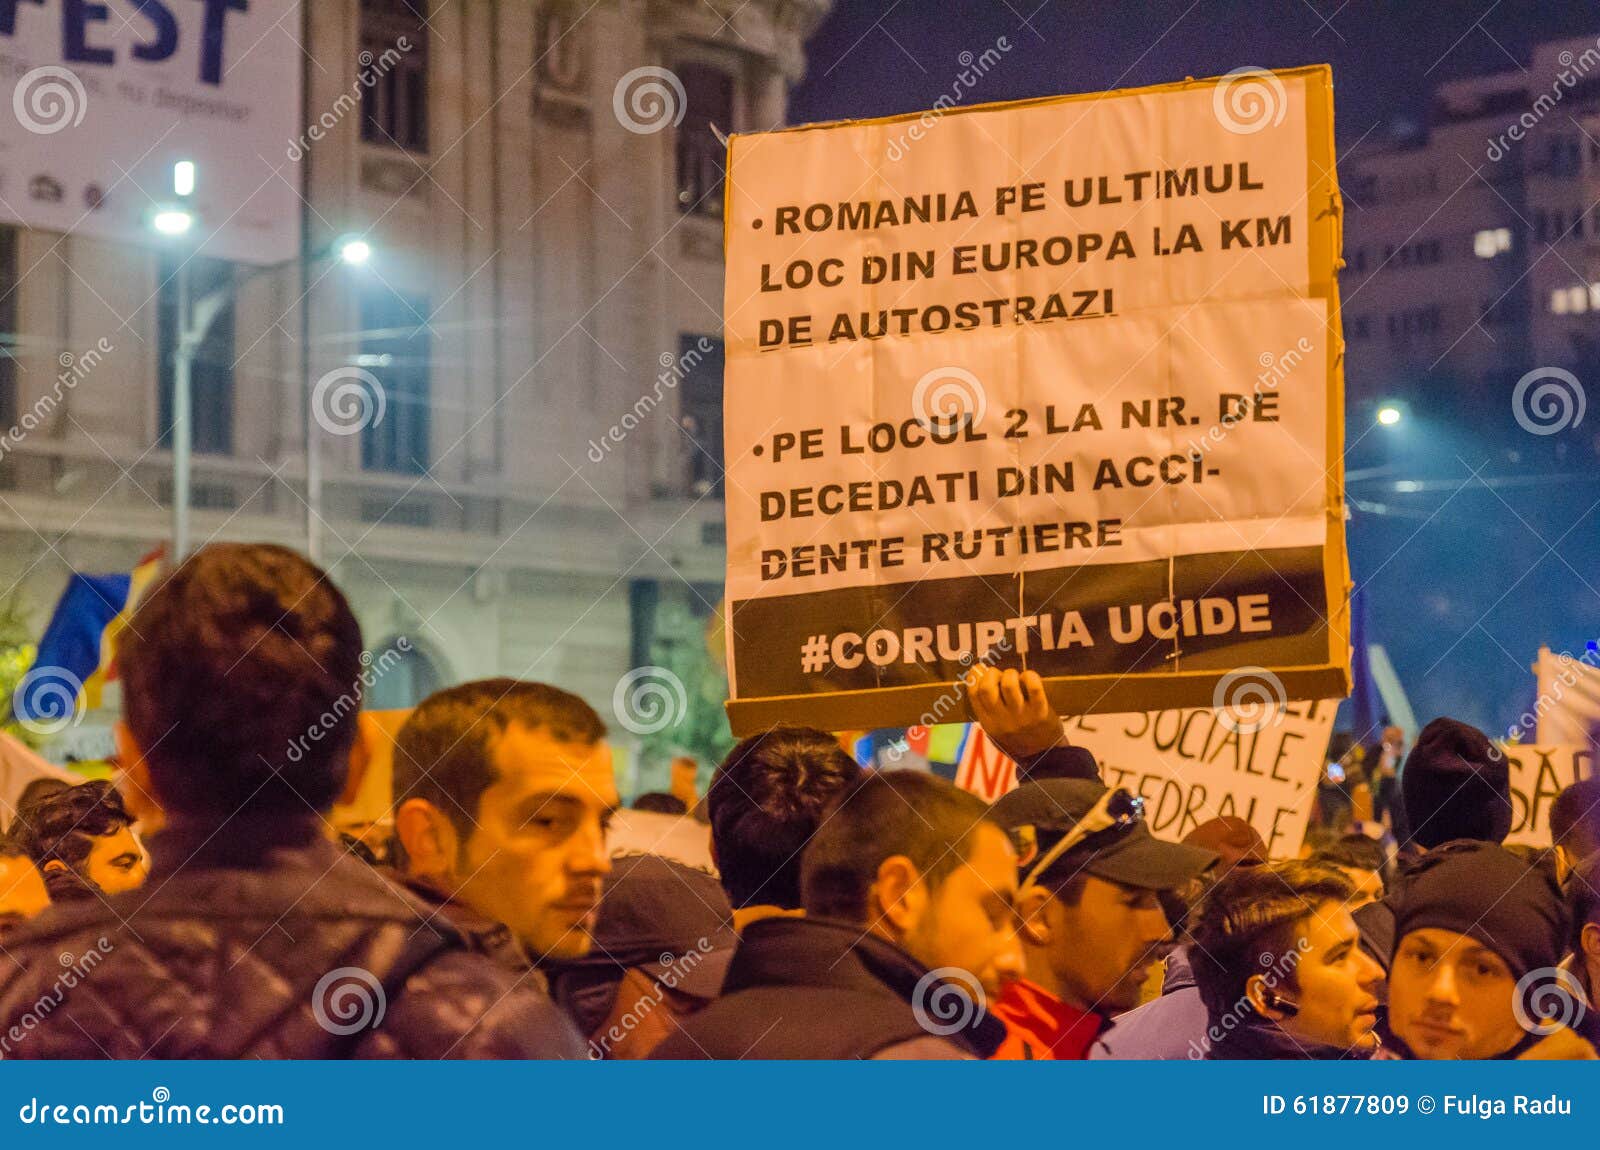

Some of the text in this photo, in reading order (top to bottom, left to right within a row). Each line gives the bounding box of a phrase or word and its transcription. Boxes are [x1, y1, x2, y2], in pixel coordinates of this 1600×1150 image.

[774, 161, 1264, 235] ROMANIA PE ULTIMUL
[760, 215, 1292, 293] LOC DIN EUROPA LA KM
[758, 288, 1117, 352] DE AUTOSTRAZI
[772, 391, 1281, 463] PE LOCUL 2 LA NR. DE
[760, 453, 1220, 522] DECEDATI DIN ACCI-
[760, 518, 1123, 581] DENTE RUTIERE
[800, 593, 1273, 673] #CORUPTIA UCIDE
